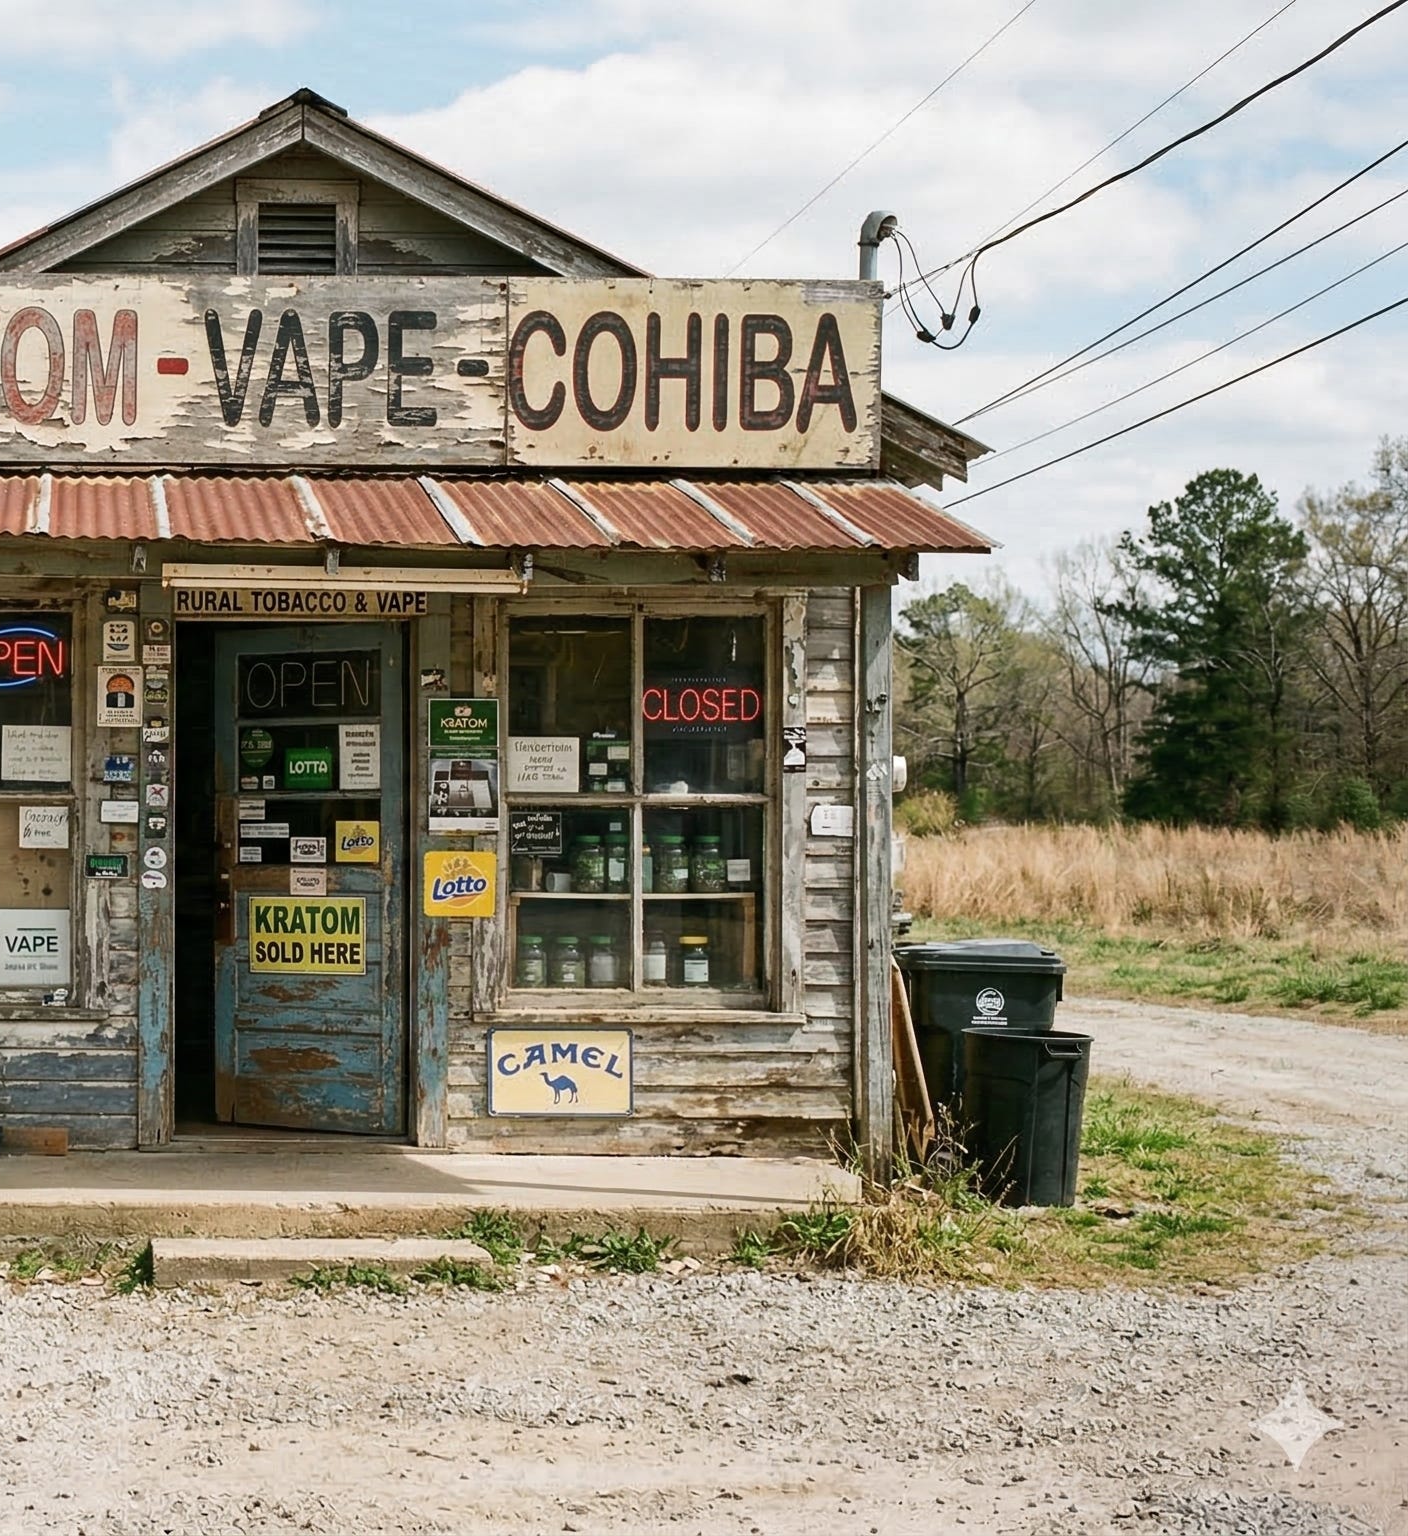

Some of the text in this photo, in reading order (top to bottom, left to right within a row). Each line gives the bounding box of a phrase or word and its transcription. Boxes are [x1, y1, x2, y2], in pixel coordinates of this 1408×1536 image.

[204, 308, 438, 430] VAPE
[509, 310, 859, 434] COHIBA
[176, 590, 427, 613] RURAL TOBACCO & VAPE
[247, 659, 370, 709] OPEN
[642, 688, 760, 721] CLOSED
[289, 760, 328, 774] LOTTA
[432, 875, 487, 901] Lotto
[255, 905, 360, 935] KRATOM
[5, 935, 59, 953] VAPE
[255, 941, 361, 965] SOLD HERE
[497, 1043, 623, 1079] CAMEL
